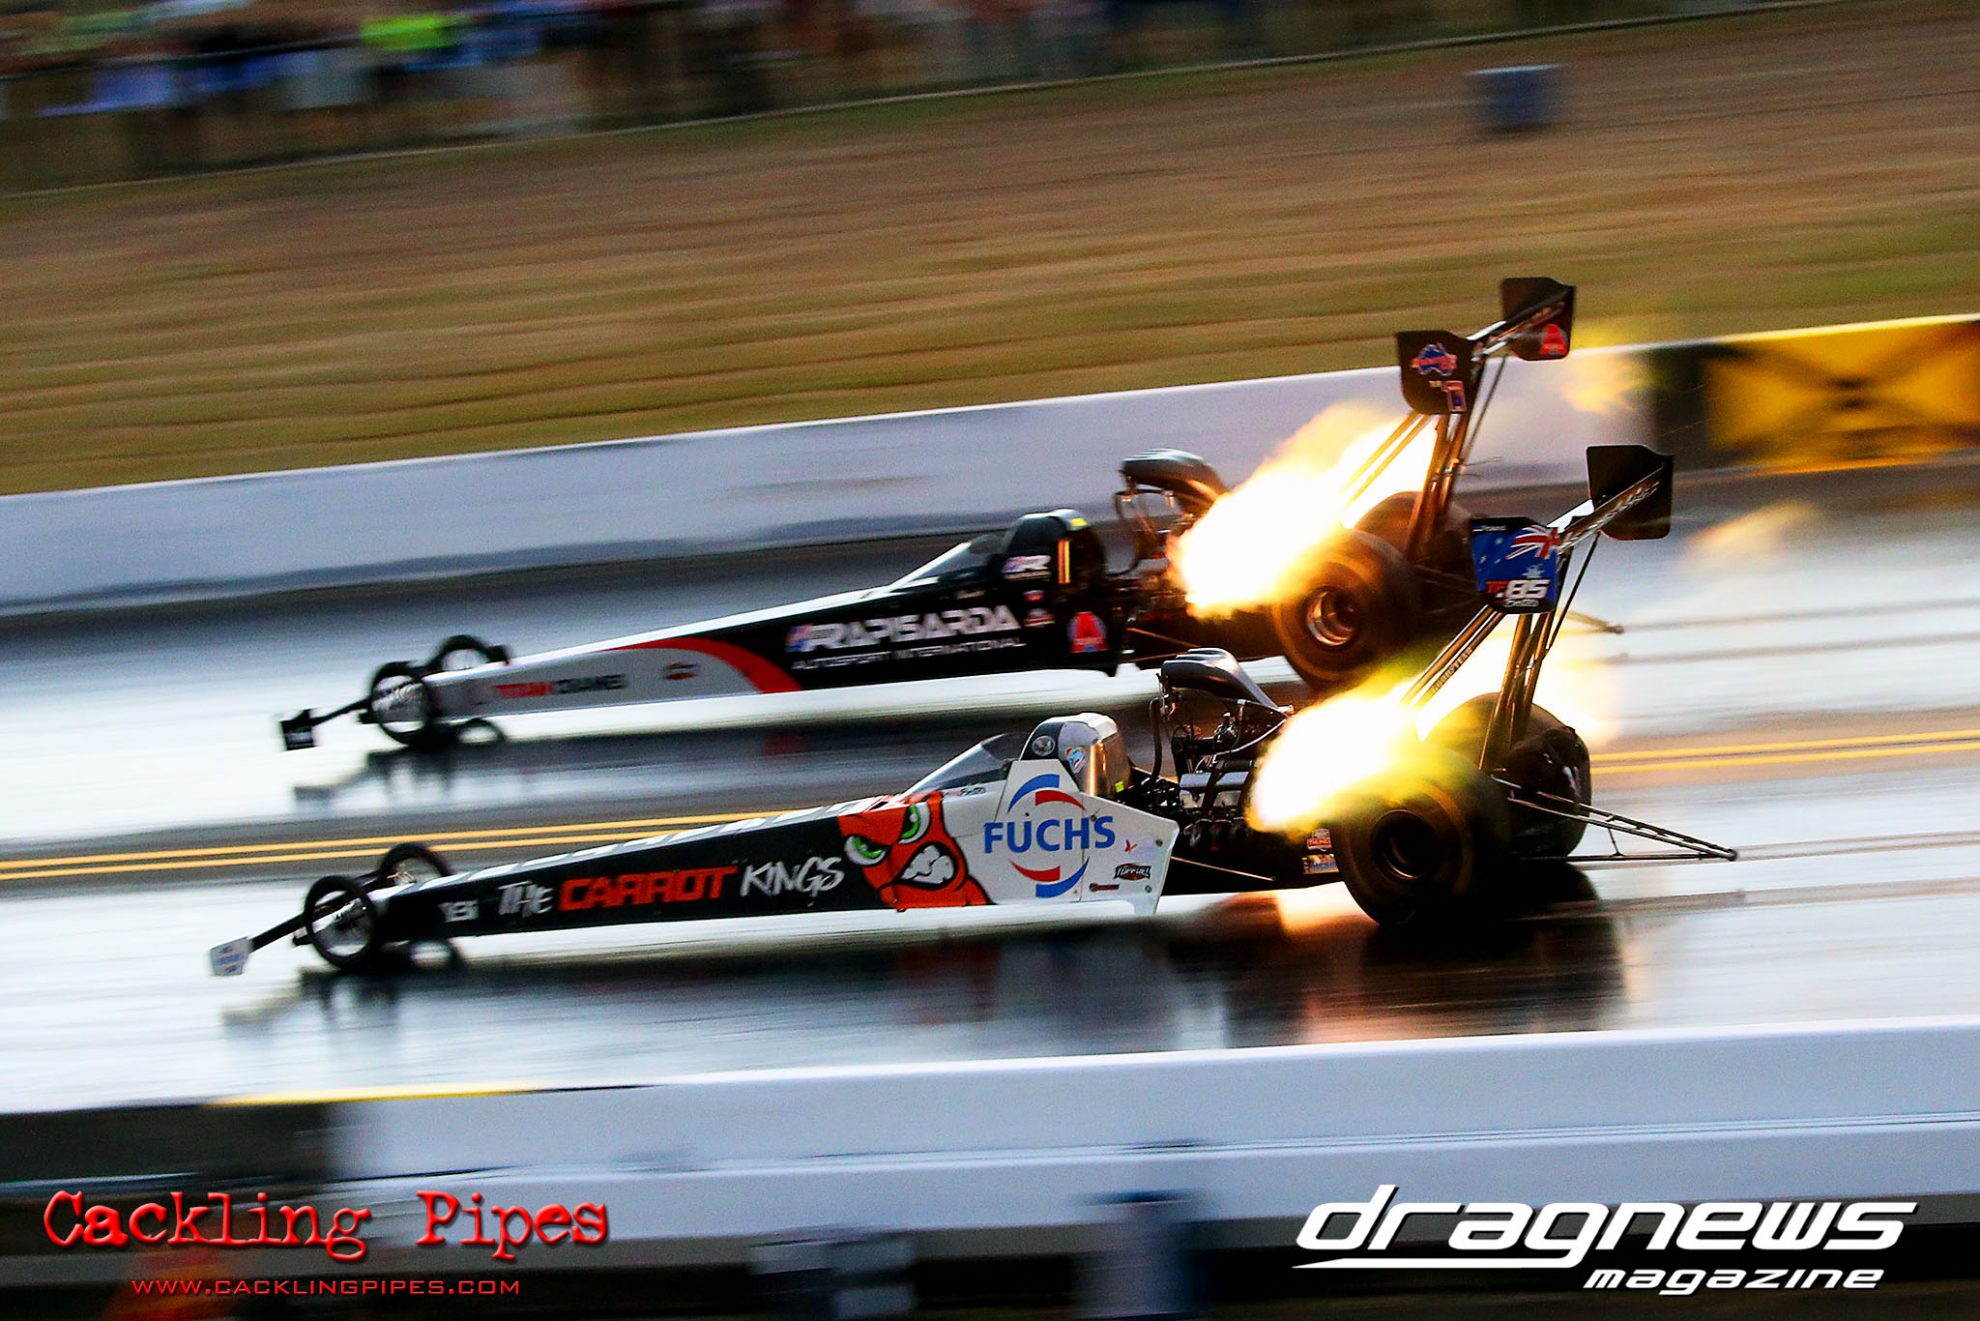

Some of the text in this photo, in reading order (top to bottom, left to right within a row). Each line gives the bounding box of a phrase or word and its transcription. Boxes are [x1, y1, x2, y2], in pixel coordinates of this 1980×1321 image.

[786, 604, 1022, 652] RAPISARDA
[984, 815, 1115, 854] FUCHS
[559, 865, 738, 911] CARROT
[740, 856, 844, 898] KINGS
